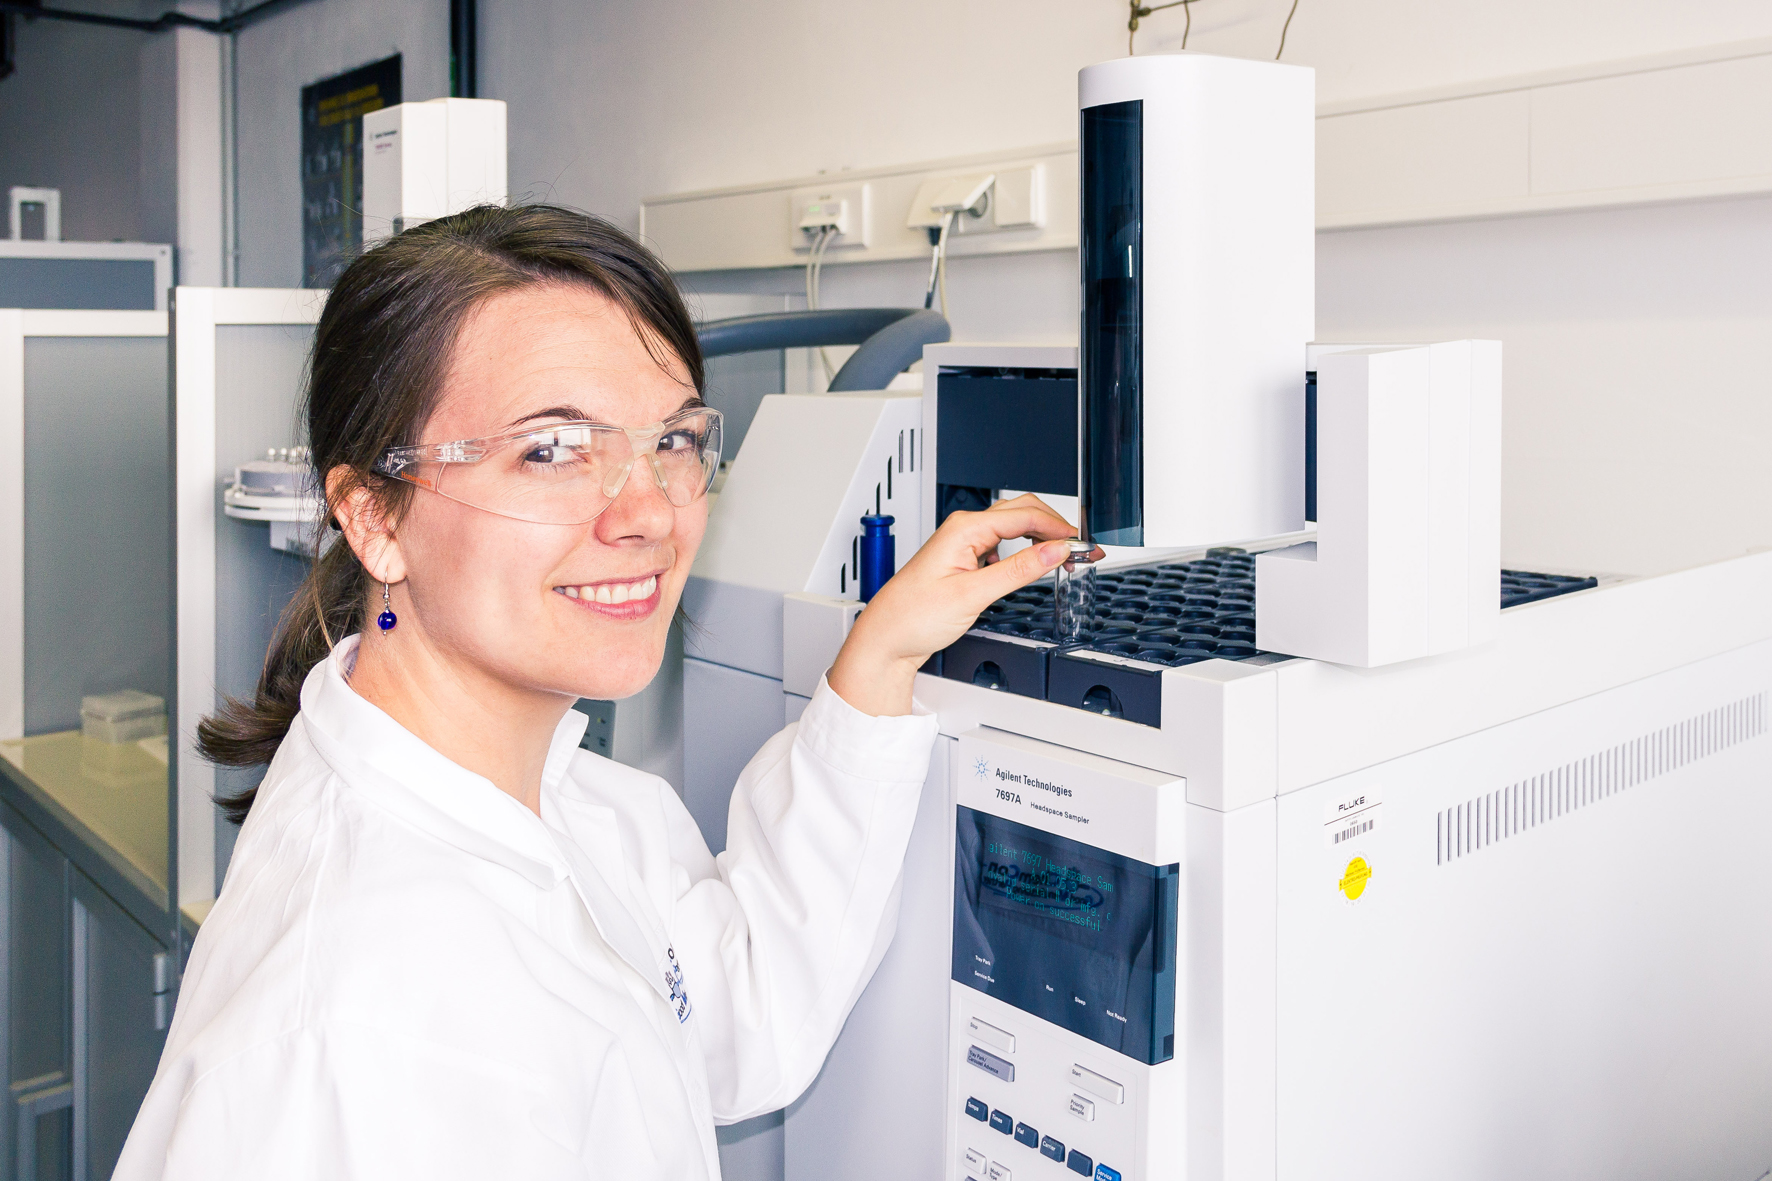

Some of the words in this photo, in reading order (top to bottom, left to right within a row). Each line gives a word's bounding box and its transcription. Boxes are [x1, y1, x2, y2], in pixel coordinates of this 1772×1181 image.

[995, 768, 1021, 783] Agilent
[1023, 775, 1073, 797] Technologies
[995, 788, 1022, 805] 7697A
[1030, 801, 1063, 817] Headspace
[1064, 811, 1089, 824] Sampler
[1338, 796, 1365, 812] FLUKE
[1022, 850, 1041, 868] 7697
[1045, 858, 1092, 885] Headspace
[1021, 880, 1050, 899] serial
[1065, 896, 1075, 908] or
[1006, 887, 1030, 905] Power
[1034, 900, 1045, 912] on
[1050, 906, 1101, 931] successful
[1045, 984, 1054, 992] Run
[1106, 1009, 1114, 1018] Not
[1115, 1012, 1127, 1023] Ready
[1071, 1068, 1081, 1077] Start
[1069, 1104, 1085, 1116] Sample
[1070, 1099, 1085, 1110] Priority
[1016, 1127, 1025, 1135] Vial
